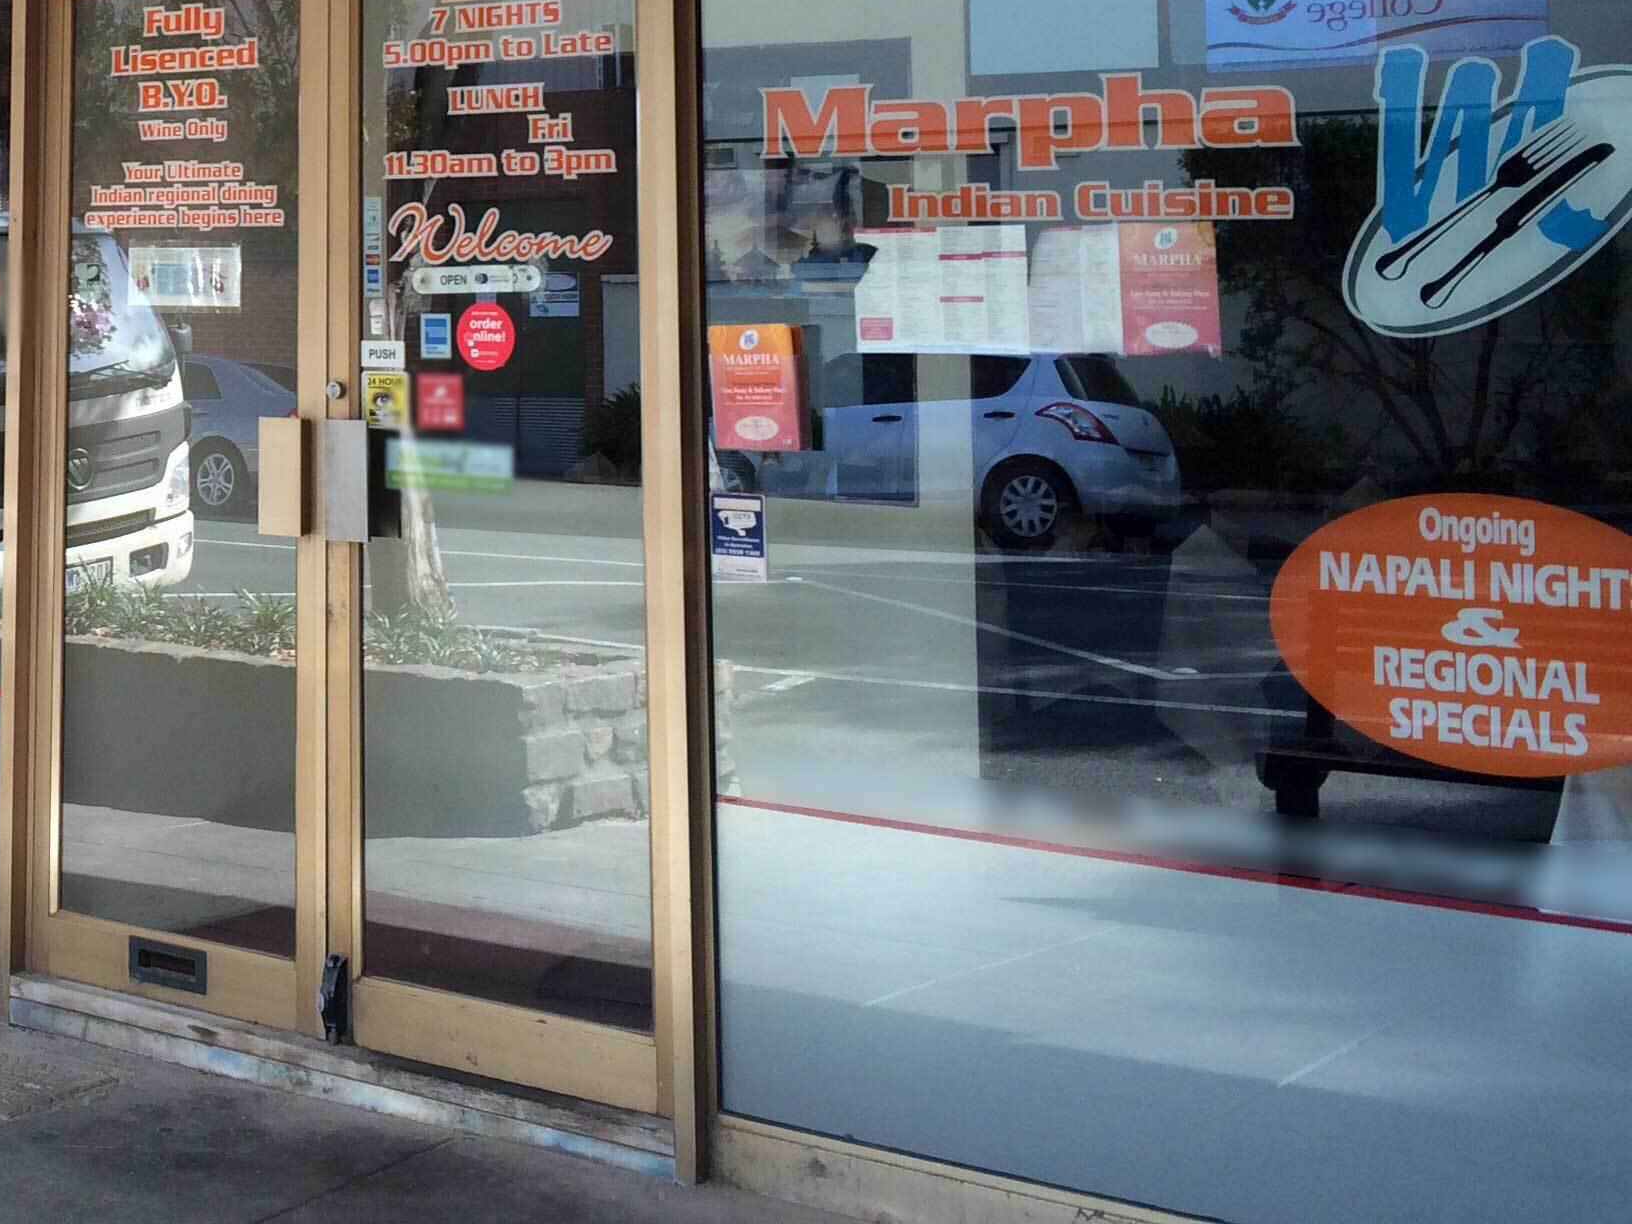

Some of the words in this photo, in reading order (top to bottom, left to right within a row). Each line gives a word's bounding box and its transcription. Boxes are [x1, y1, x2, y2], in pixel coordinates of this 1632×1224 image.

[143, 4, 225, 40] Fully
[430, 7, 449, 35] 7
[455, 0, 561, 33] NIGHTS
[111, 37, 258, 76] Lisenced
[383, 38, 495, 69] 5.00pm
[500, 35, 536, 60] to
[541, 30, 614, 58] Late
[138, 78, 227, 112] B.Y.O.
[447, 82, 545, 115] LUNCH
[138, 120, 183, 140] Wine
[186, 117, 227, 142] Only
[527, 112, 574, 143] Fri
[758, 72, 1302, 172] Marpha
[122, 162, 163, 182] Your
[164, 160, 243, 181] Ultimate
[383, 150, 498, 179] 11.30am
[501, 149, 540, 176] to
[544, 146, 617, 179] 3pm
[91, 185, 144, 206] Indian
[146, 184, 218, 208] regional
[220, 182, 277, 207] dining
[888, 183, 1063, 222] Indian
[1074, 179, 1294, 221] Cuisine
[85, 208, 177, 232] experience
[178, 206, 238, 231] begins
[240, 206, 284, 226] here
[389, 202, 613, 264] Welcome
[1134, 253, 1202, 266] MARPHA
[440, 274, 467, 286] OPEN
[469, 318, 502, 329] order
[368, 348, 396, 359] PUSH
[723, 353, 780, 366] MARPHA
[1419, 507, 1535, 556] Ongoing
[1319, 551, 1475, 600] NAPALI
[1489, 561, 1632, 611] NIGHT
[1440, 608, 1522, 649] &
[1373, 647, 1600, 704] REGIONAL
[1389, 698, 1589, 756] SPECIALS
